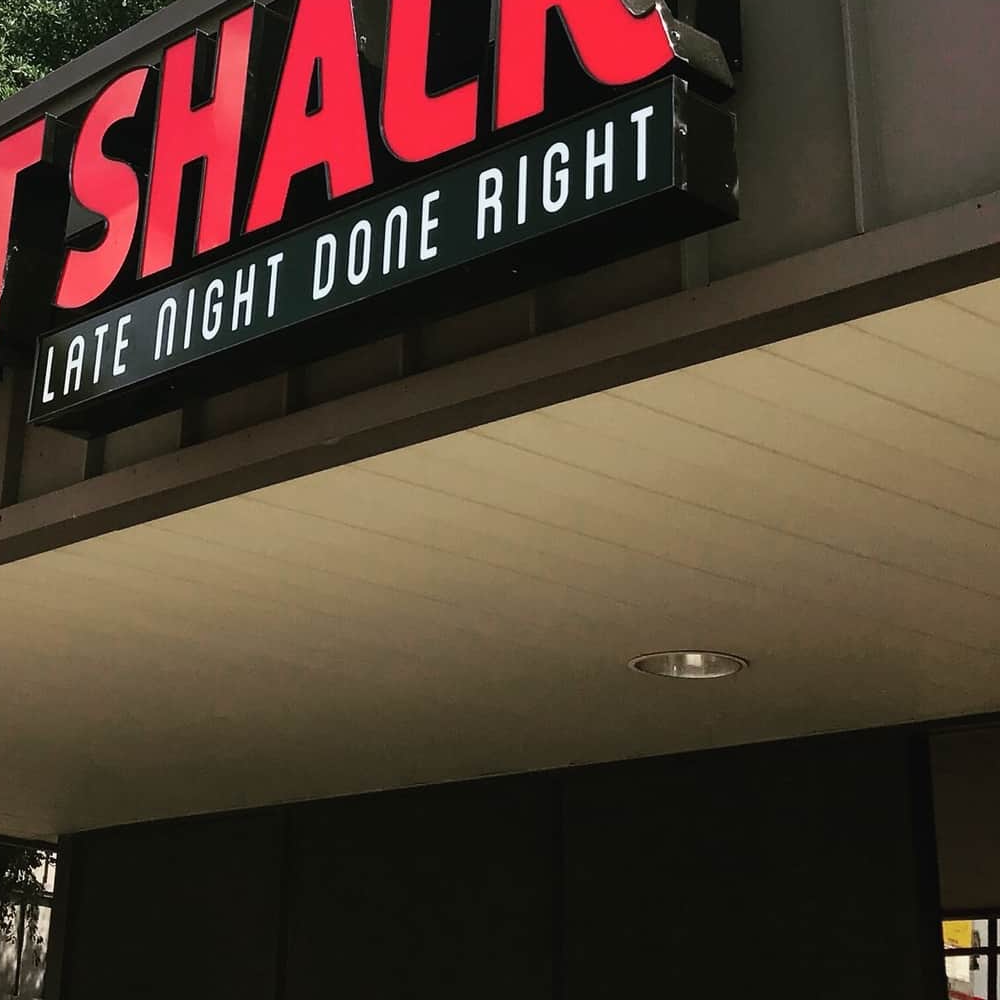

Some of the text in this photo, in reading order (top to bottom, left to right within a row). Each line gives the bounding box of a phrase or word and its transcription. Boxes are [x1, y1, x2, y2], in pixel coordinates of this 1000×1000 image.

[41, 104, 655, 404] LATE NIGHT DONE RIGHT
